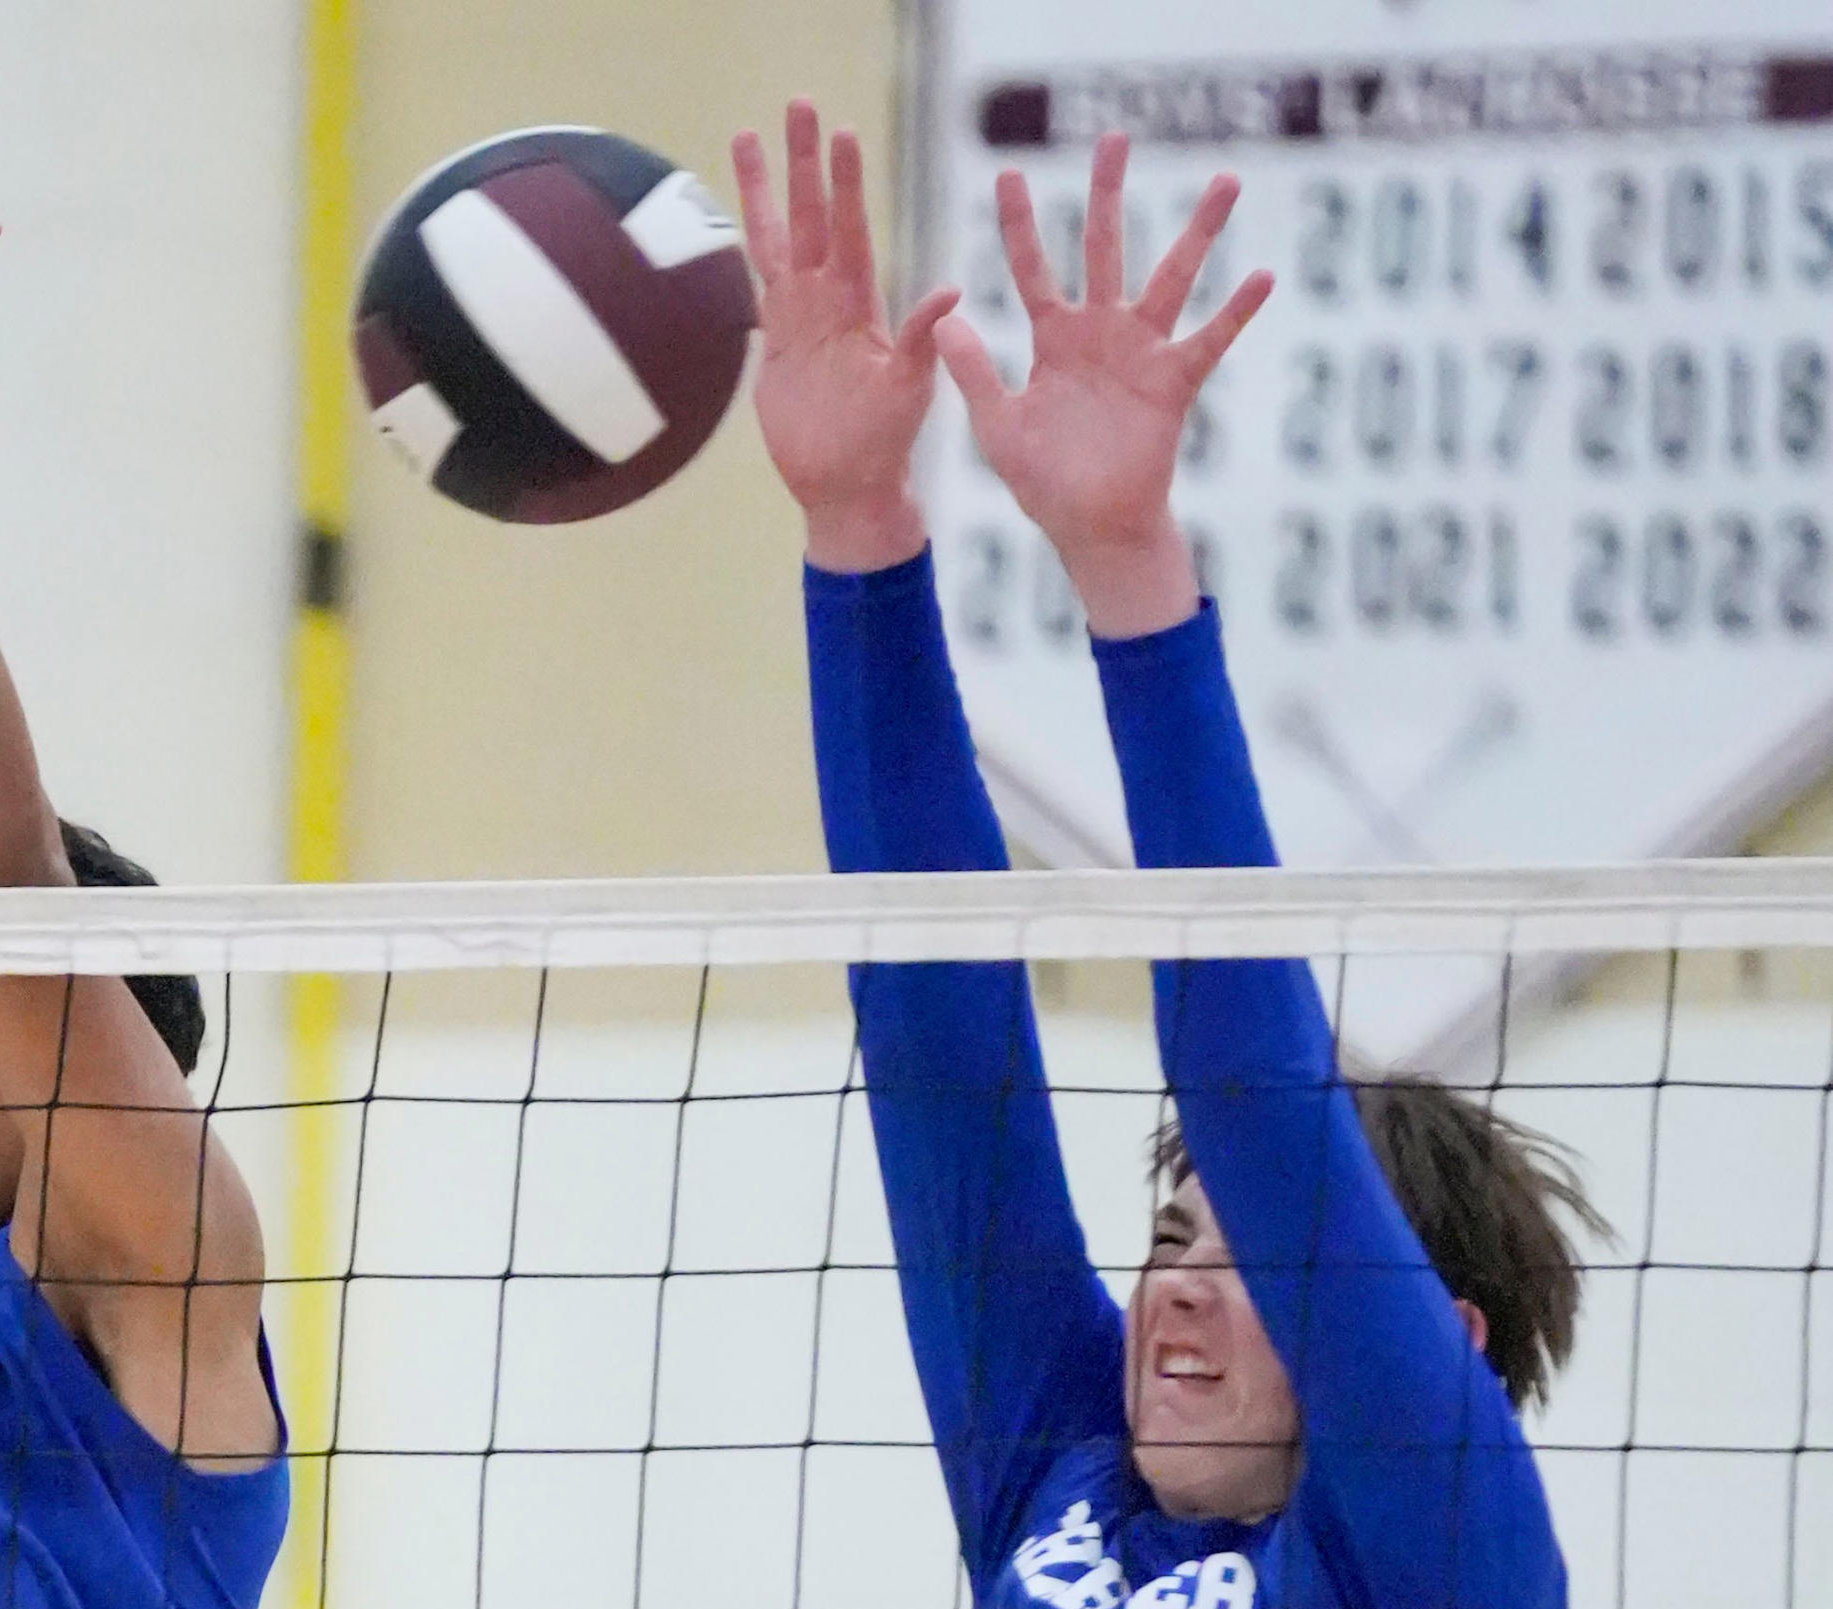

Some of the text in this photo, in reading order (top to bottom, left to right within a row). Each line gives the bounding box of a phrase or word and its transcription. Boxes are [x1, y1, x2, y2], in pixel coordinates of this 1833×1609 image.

[1295, 178, 1553, 298] 2014
[1279, 345, 1543, 466] 2017
[1577, 342, 1831, 462] 2018
[1275, 508, 1519, 632] 2021
[1572, 512, 1827, 638] 2022
